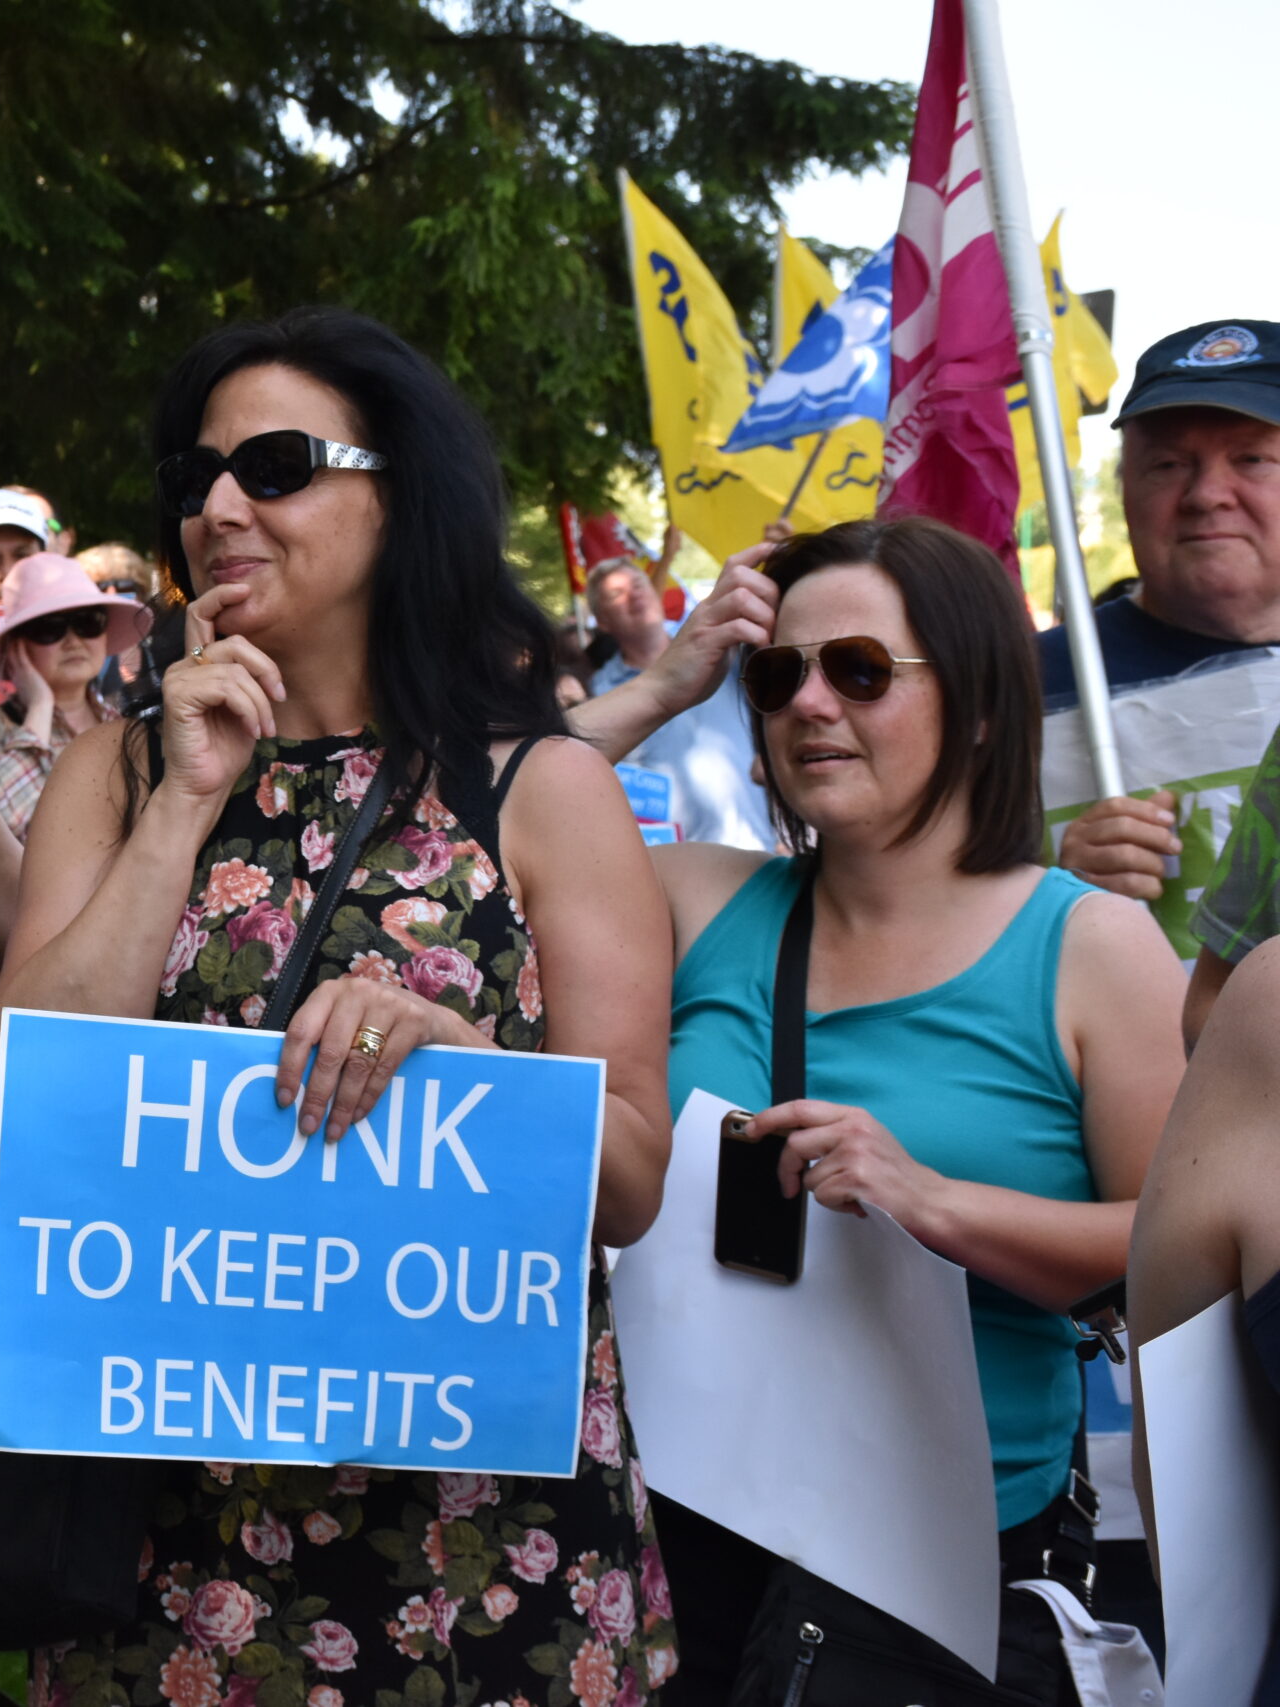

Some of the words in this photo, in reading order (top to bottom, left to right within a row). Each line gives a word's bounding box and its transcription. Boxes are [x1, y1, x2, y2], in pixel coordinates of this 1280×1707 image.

[121, 1054, 495, 1195] HONK
[18, 1216, 133, 1300] TO
[160, 1226, 360, 1312] KEEP
[385, 1242, 562, 1328] OUR
[99, 1356, 475, 1452] BENEFITS
